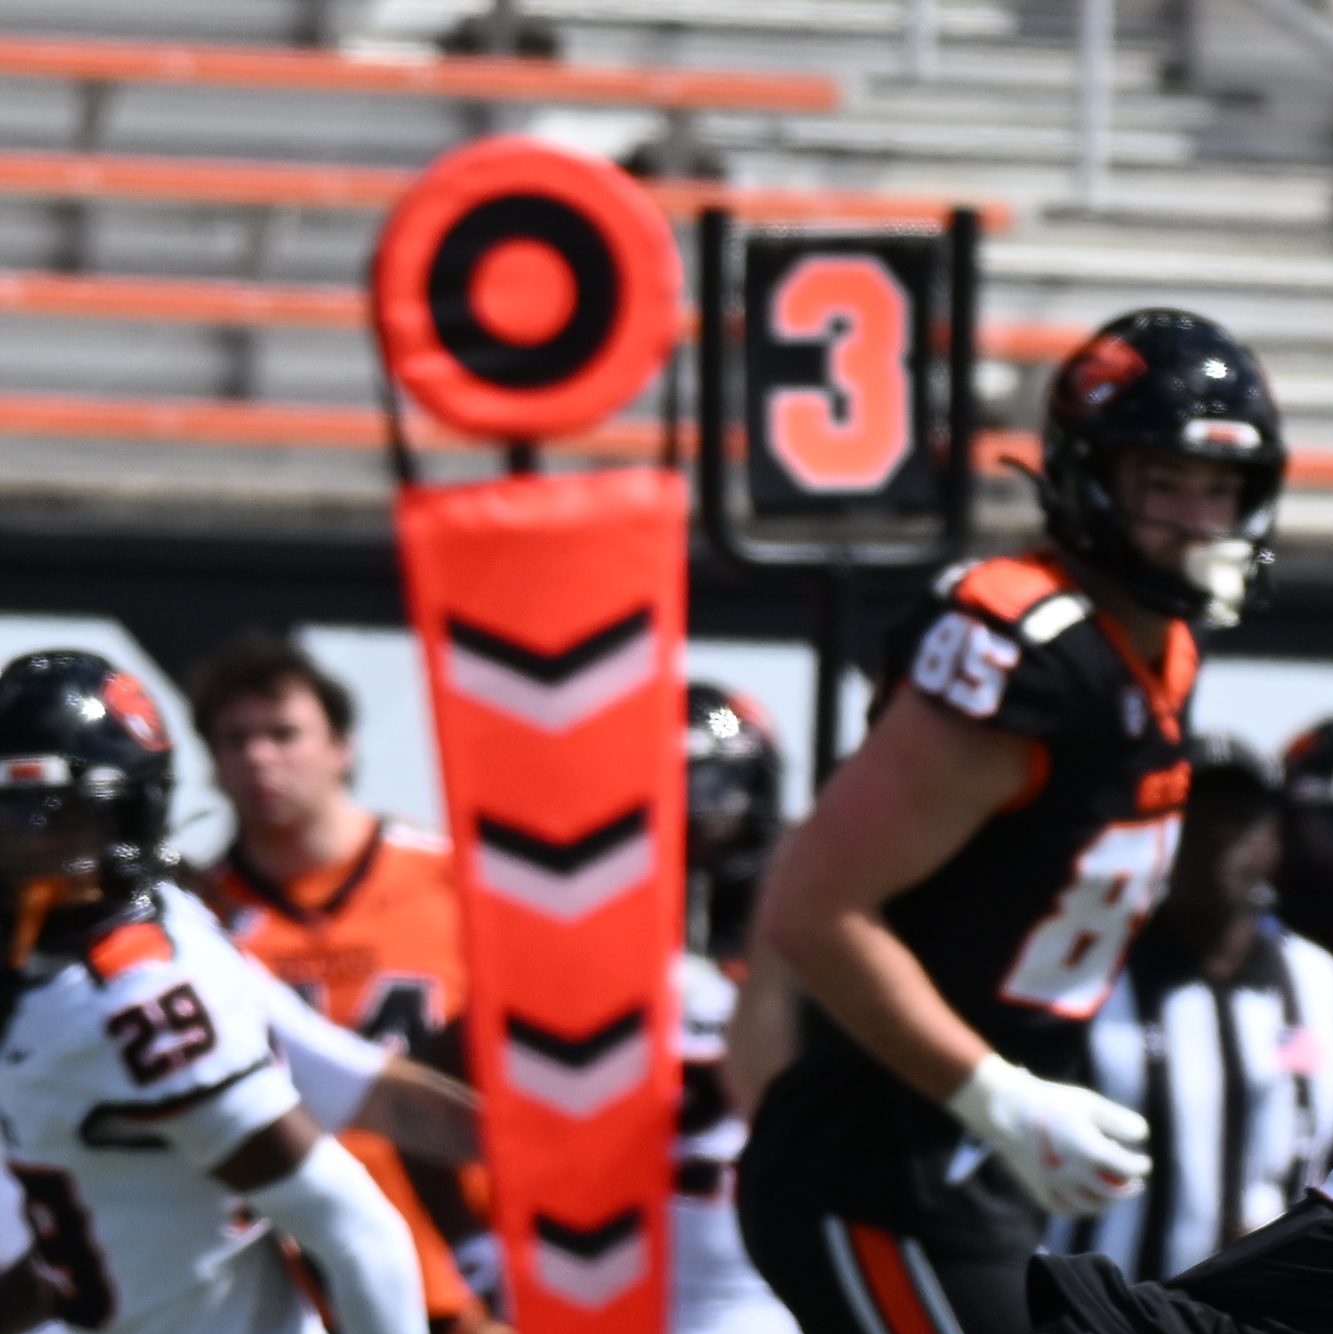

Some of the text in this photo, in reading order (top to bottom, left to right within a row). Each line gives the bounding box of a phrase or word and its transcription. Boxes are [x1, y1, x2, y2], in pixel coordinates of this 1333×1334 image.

[768, 255, 914, 492] 3
[910, 610, 1022, 718] 85
[998, 815, 1186, 1020] 8
[104, 981, 216, 1088] 29
